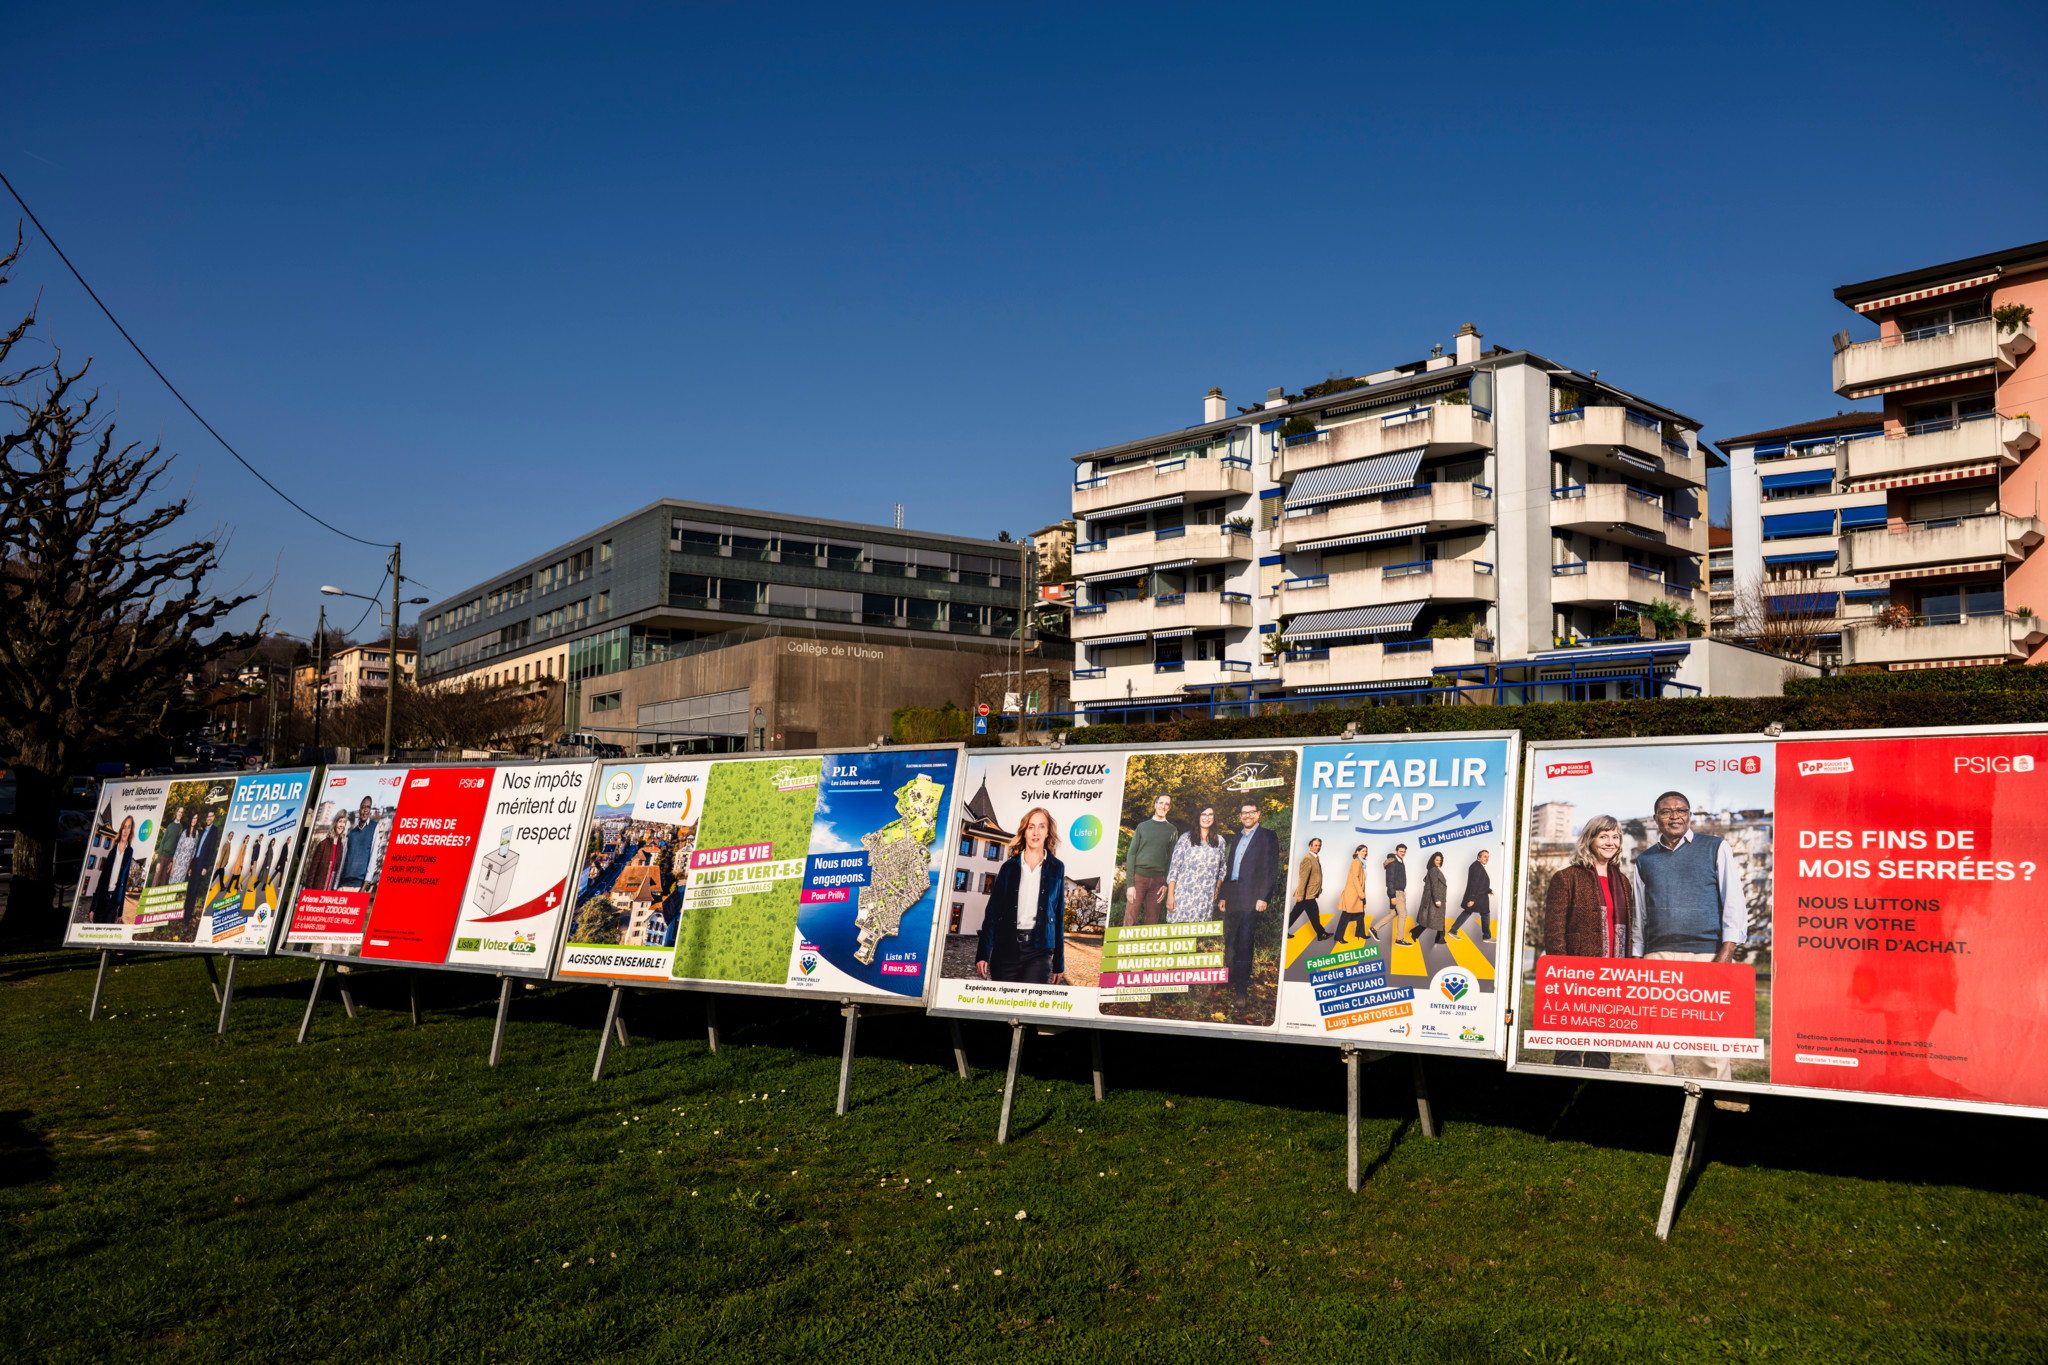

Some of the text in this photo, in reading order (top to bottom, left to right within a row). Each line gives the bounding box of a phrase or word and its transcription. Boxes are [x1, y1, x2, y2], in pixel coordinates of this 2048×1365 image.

[788, 642, 828, 656] Collège
[831, 645, 844, 655] de
[832, 766, 858, 777] PLR
[1312, 752, 1487, 788] RÉTABLIR
[1548, 766, 1567, 774] PoP
[1802, 763, 1823, 771] PoP
[1954, 756, 2010, 774] PSIG
[502, 770, 582, 792] Nos impôts
[612, 782, 628, 790] Liste
[237, 780, 302, 802] RÉTABLIR
[1021, 790, 1103, 802] Sylvie Krattinger
[496, 796, 577, 814] méritent du
[657, 800, 682, 808] Centre
[1309, 792, 1434, 822] LE CAP
[232, 803, 280, 822] LE CAP
[400, 818, 457, 829] DES FINS DE
[396, 834, 420, 845] MOIS
[516, 824, 572, 844] respect
[1074, 828, 1092, 837] Liste
[1421, 822, 1490, 846] à la Municipalité
[1799, 830, 1974, 850] DES FINS DE
[698, 845, 770, 866] PLUS DE VIE
[814, 858, 863, 869] Nous nous
[696, 871, 725, 885] PLUS
[728, 868, 743, 881] DE
[1799, 860, 1871, 878] MOIS
[813, 873, 865, 887] engageons.
[693, 883, 771, 898] ÉLECTIONS COMMUNALES
[811, 890, 846, 900] Pour Prilly.
[319, 896, 348, 904] ZWAHLEN
[1798, 897, 1940, 912] NOUS LUTTONS
[1118, 923, 1221, 939] ANTOINE VIREDAZ
[1798, 916, 1916, 931] POUR VOTRE
[457, 938, 480, 949] Liste 2
[483, 938, 508, 950] Votez
[513, 942, 531, 951] UDC
[1118, 940, 1194, 954] REBECCA JOLY
[1798, 936, 1971, 954] POUVOIR D'ACHAT.
[568, 954, 612, 965] AGISSONS
[1117, 954, 1221, 970] MAURIZIO MATTIA
[1307, 947, 1378, 969] Fabien DEILLON
[1117, 968, 1226, 984] À LA MUNICIPALITÉ
[1312, 962, 1383, 984] Aurélie BARBEY
[1545, 965, 1684, 984] Ariane ZWAHLEN
[965, 984, 998, 992] Expérience,
[1317, 978, 1384, 998] Tony CAPUANO
[1544, 982, 1731, 1005] et Vincent ZODOGOME
[958, 995, 974, 1004] Pour
[987, 997, 1037, 1009] Municipalité
[1052, 1001, 1073, 1012] Prilly
[1322, 989, 1410, 1013] Lumia CLARAMUNT
[1327, 1006, 1409, 1028] Luigi SARTORELLI
[1543, 999, 1725, 1021] À LA MUNICIPALITÉ DE PRILLY
[1543, 1014, 1638, 1030] LE 8 MARS 2026
[1528, 1036, 1760, 1053] AVEC ROGER NORDMANN AU CONSEIL D'ÉTAT
[1900, 1050, 1927, 1058] Vincent
[1929, 1052, 1968, 1062] Zodogome
